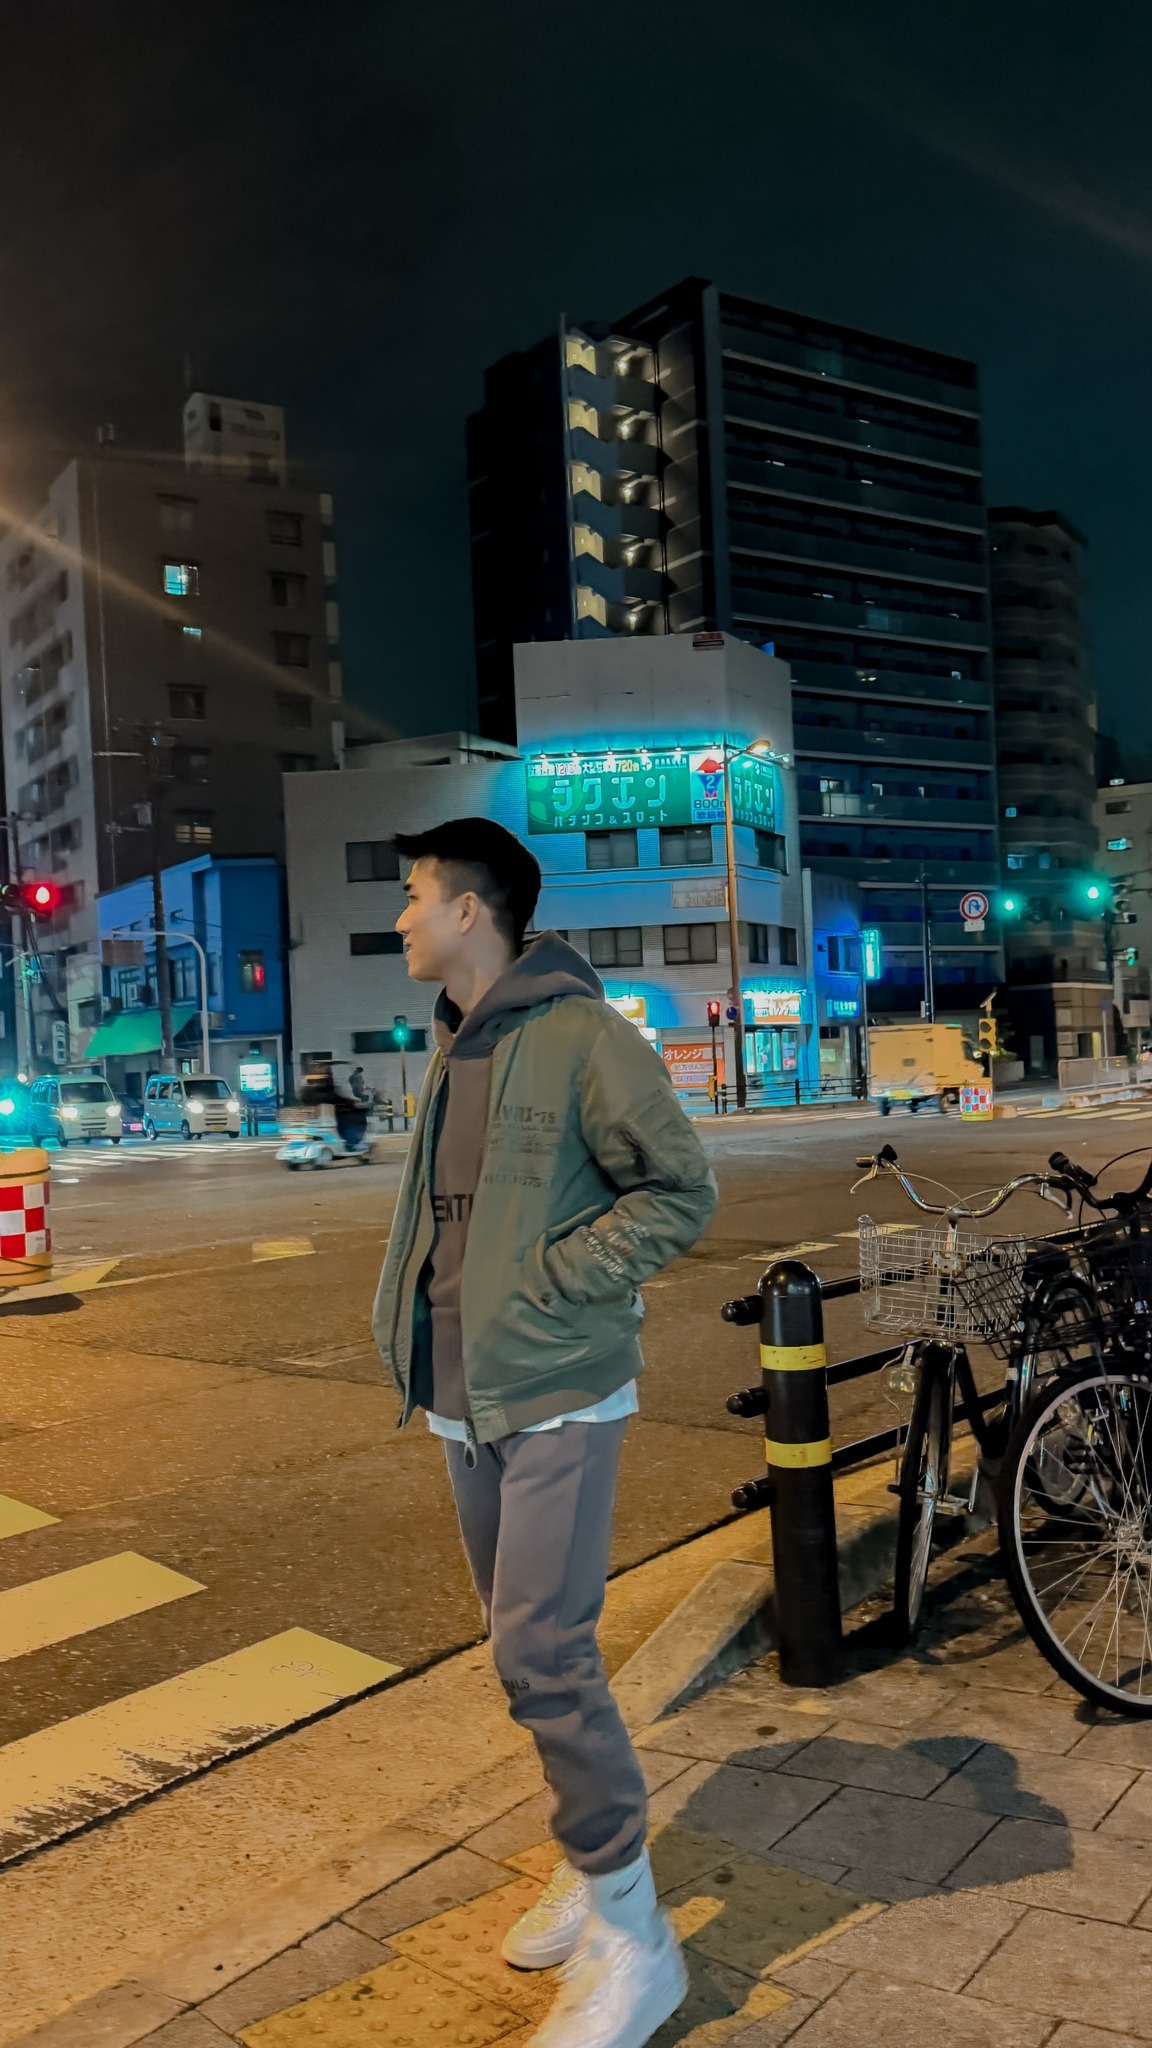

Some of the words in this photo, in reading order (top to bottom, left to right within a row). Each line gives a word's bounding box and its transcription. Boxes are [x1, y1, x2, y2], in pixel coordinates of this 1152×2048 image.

[553, 774, 666, 812] ラクエン
[706, 775, 715, 789] 2
[734, 776, 774, 815] ラクエン
